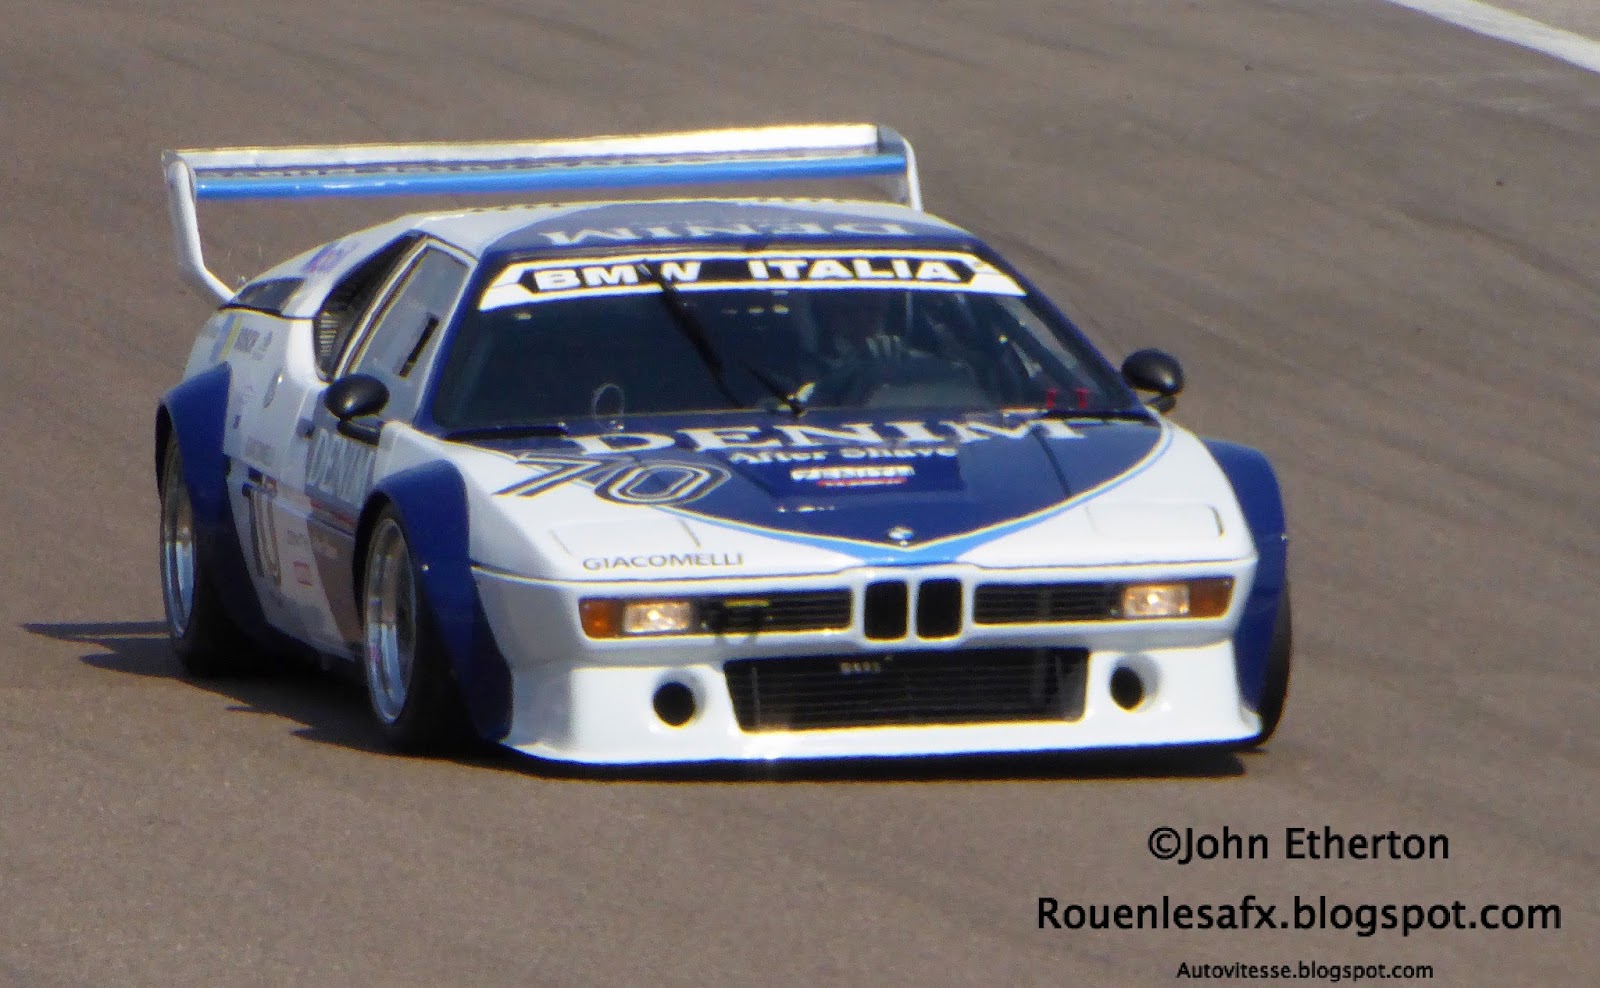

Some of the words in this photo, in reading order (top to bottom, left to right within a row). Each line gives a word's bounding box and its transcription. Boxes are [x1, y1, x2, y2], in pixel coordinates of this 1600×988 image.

[532, 259, 702, 291] BMW
[747, 257, 962, 283] ITALIA
[564, 418, 1086, 455] DENIM
[729, 451, 828, 465] After
[838, 447, 958, 459] Shave
[491, 451, 733, 507] 70
[582, 552, 745, 571] GIACOMELLI
